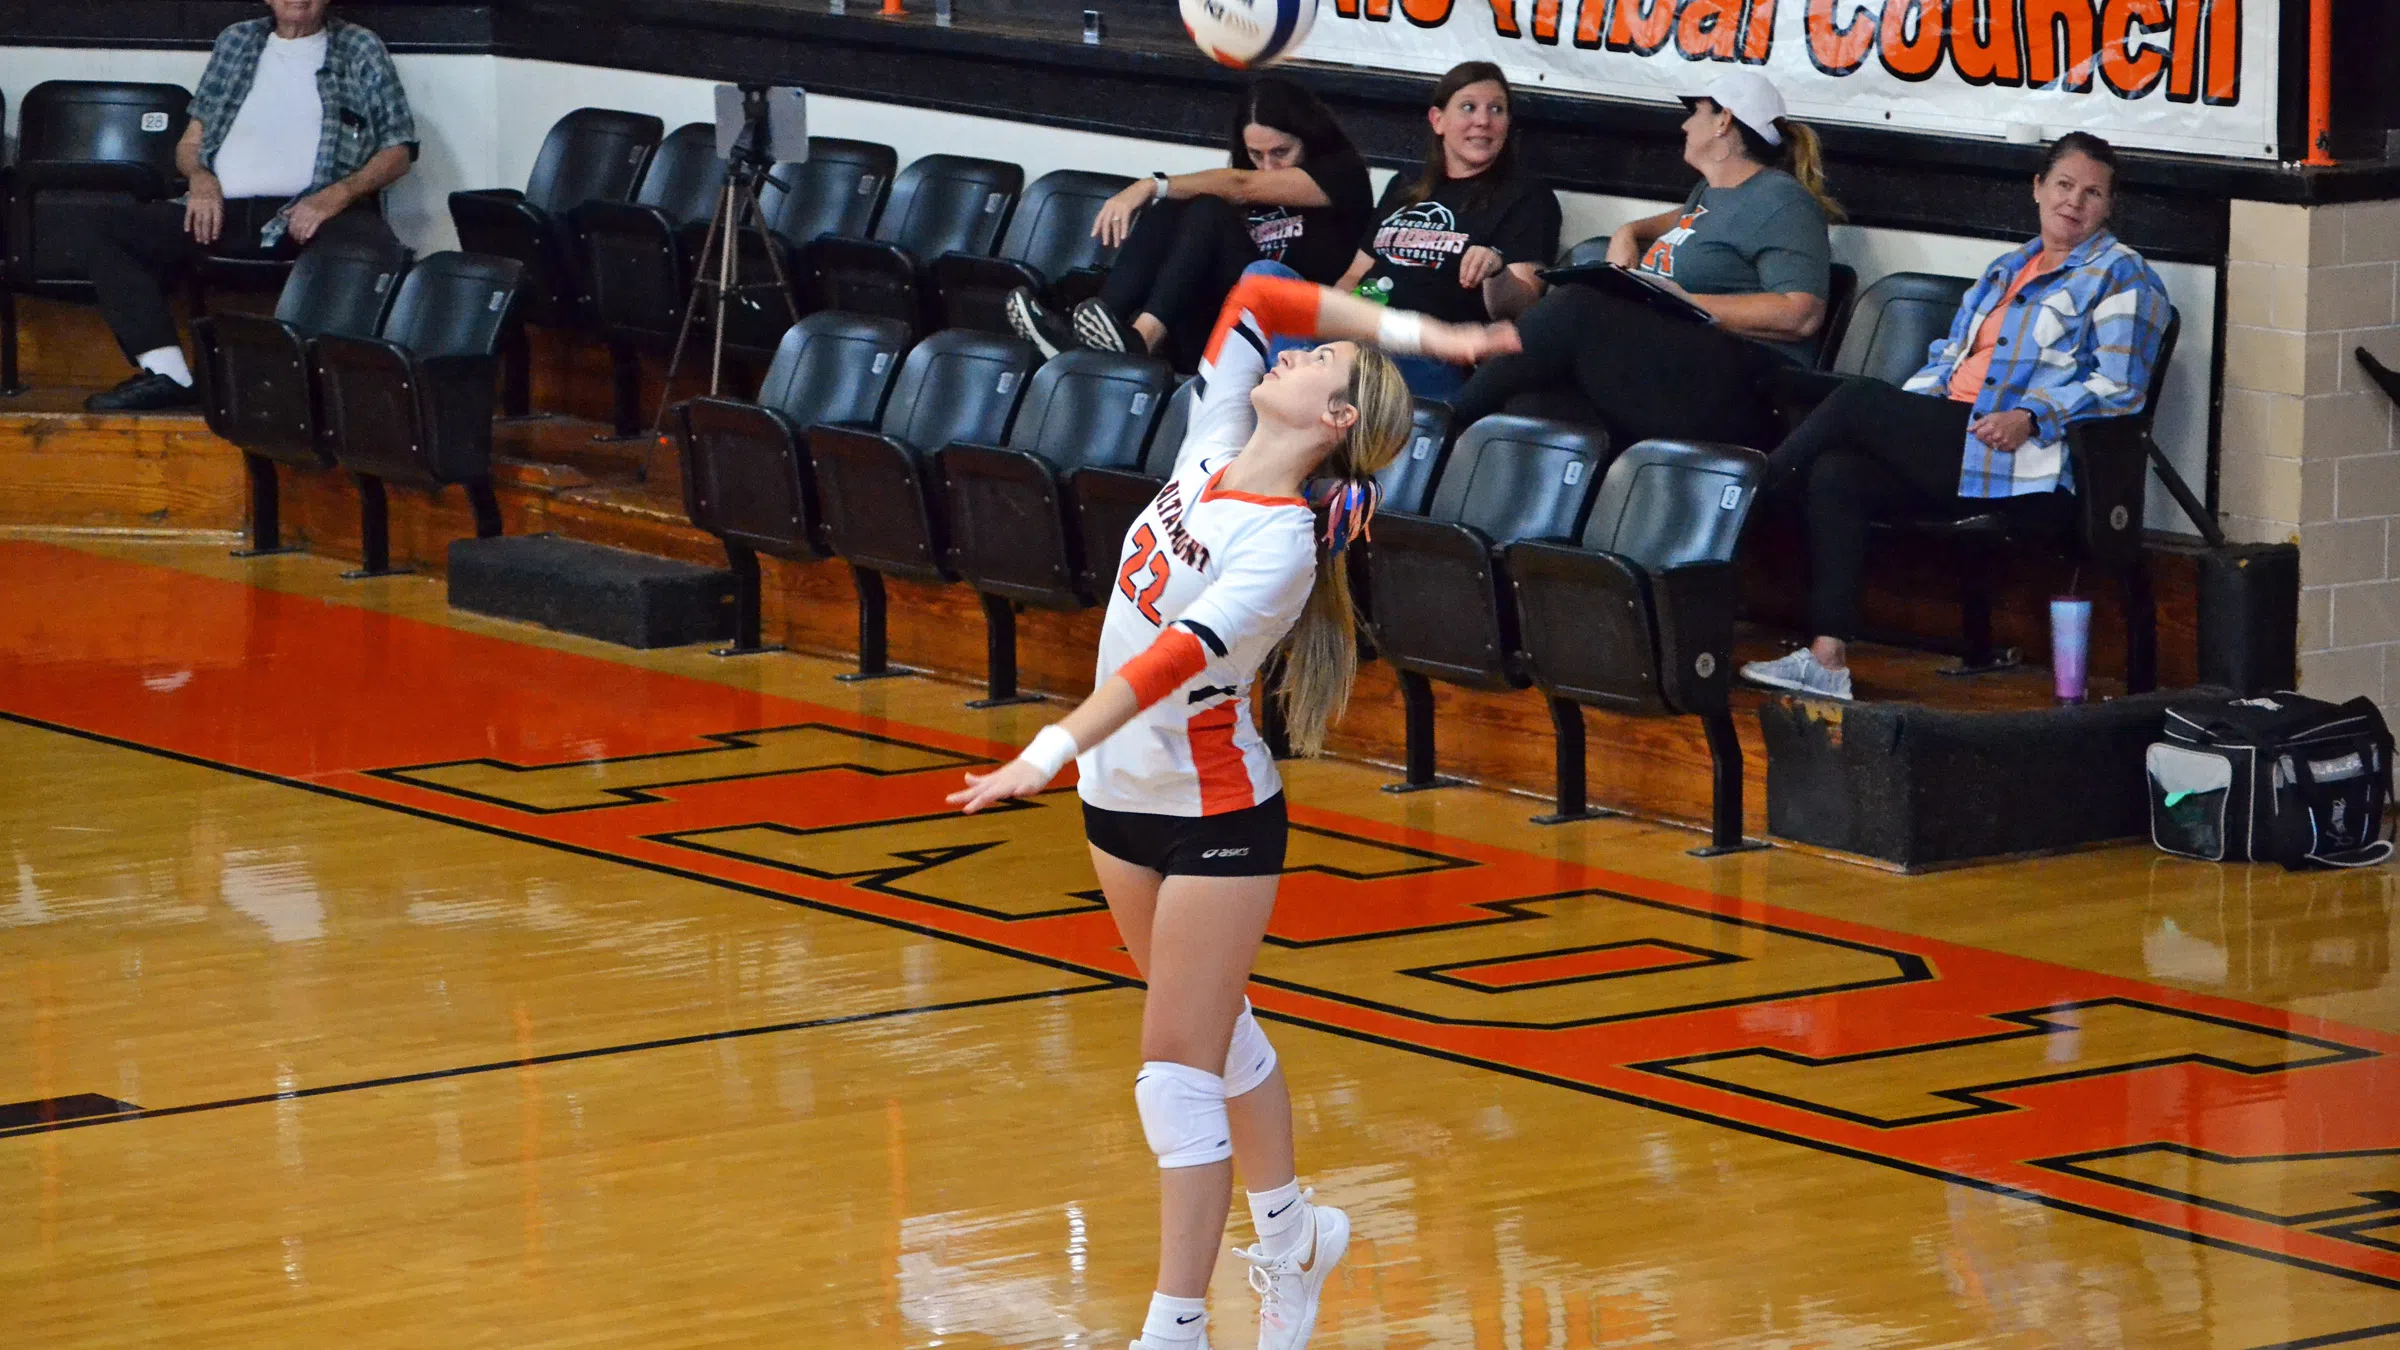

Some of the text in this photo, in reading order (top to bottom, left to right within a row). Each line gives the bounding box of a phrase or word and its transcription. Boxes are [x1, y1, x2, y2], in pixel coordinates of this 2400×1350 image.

[1117, 522, 1171, 629] 22
[1156, 479, 1210, 574] ALTAMONT
[1217, 846, 1251, 858] asics
[358, 722, 2400, 1252] INDI
